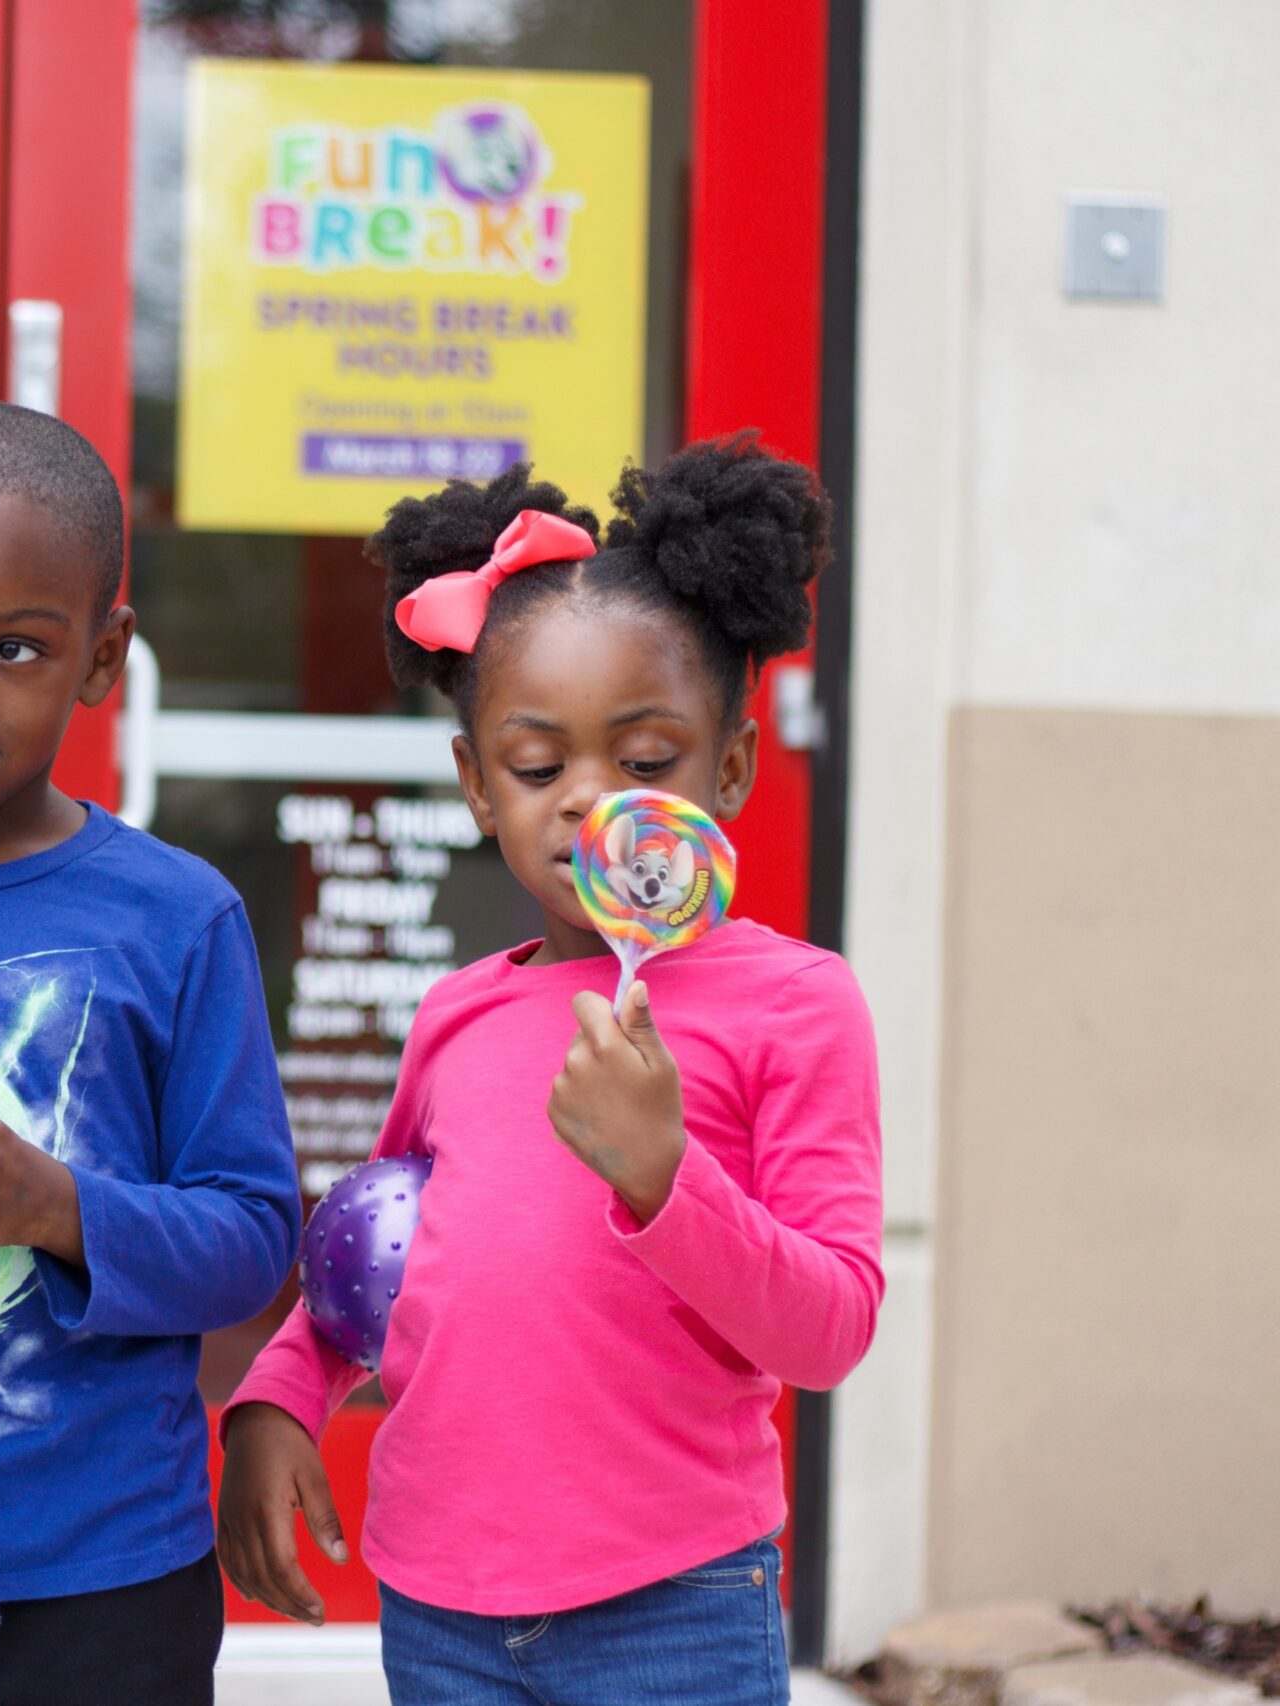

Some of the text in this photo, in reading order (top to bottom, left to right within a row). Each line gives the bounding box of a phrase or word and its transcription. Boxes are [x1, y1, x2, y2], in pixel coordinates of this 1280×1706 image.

[256, 292, 577, 341] SPRING BREAK
[336, 341, 493, 380] HOURS
[279, 797, 352, 841] SUN
[321, 881, 435, 921] FRIDAY
